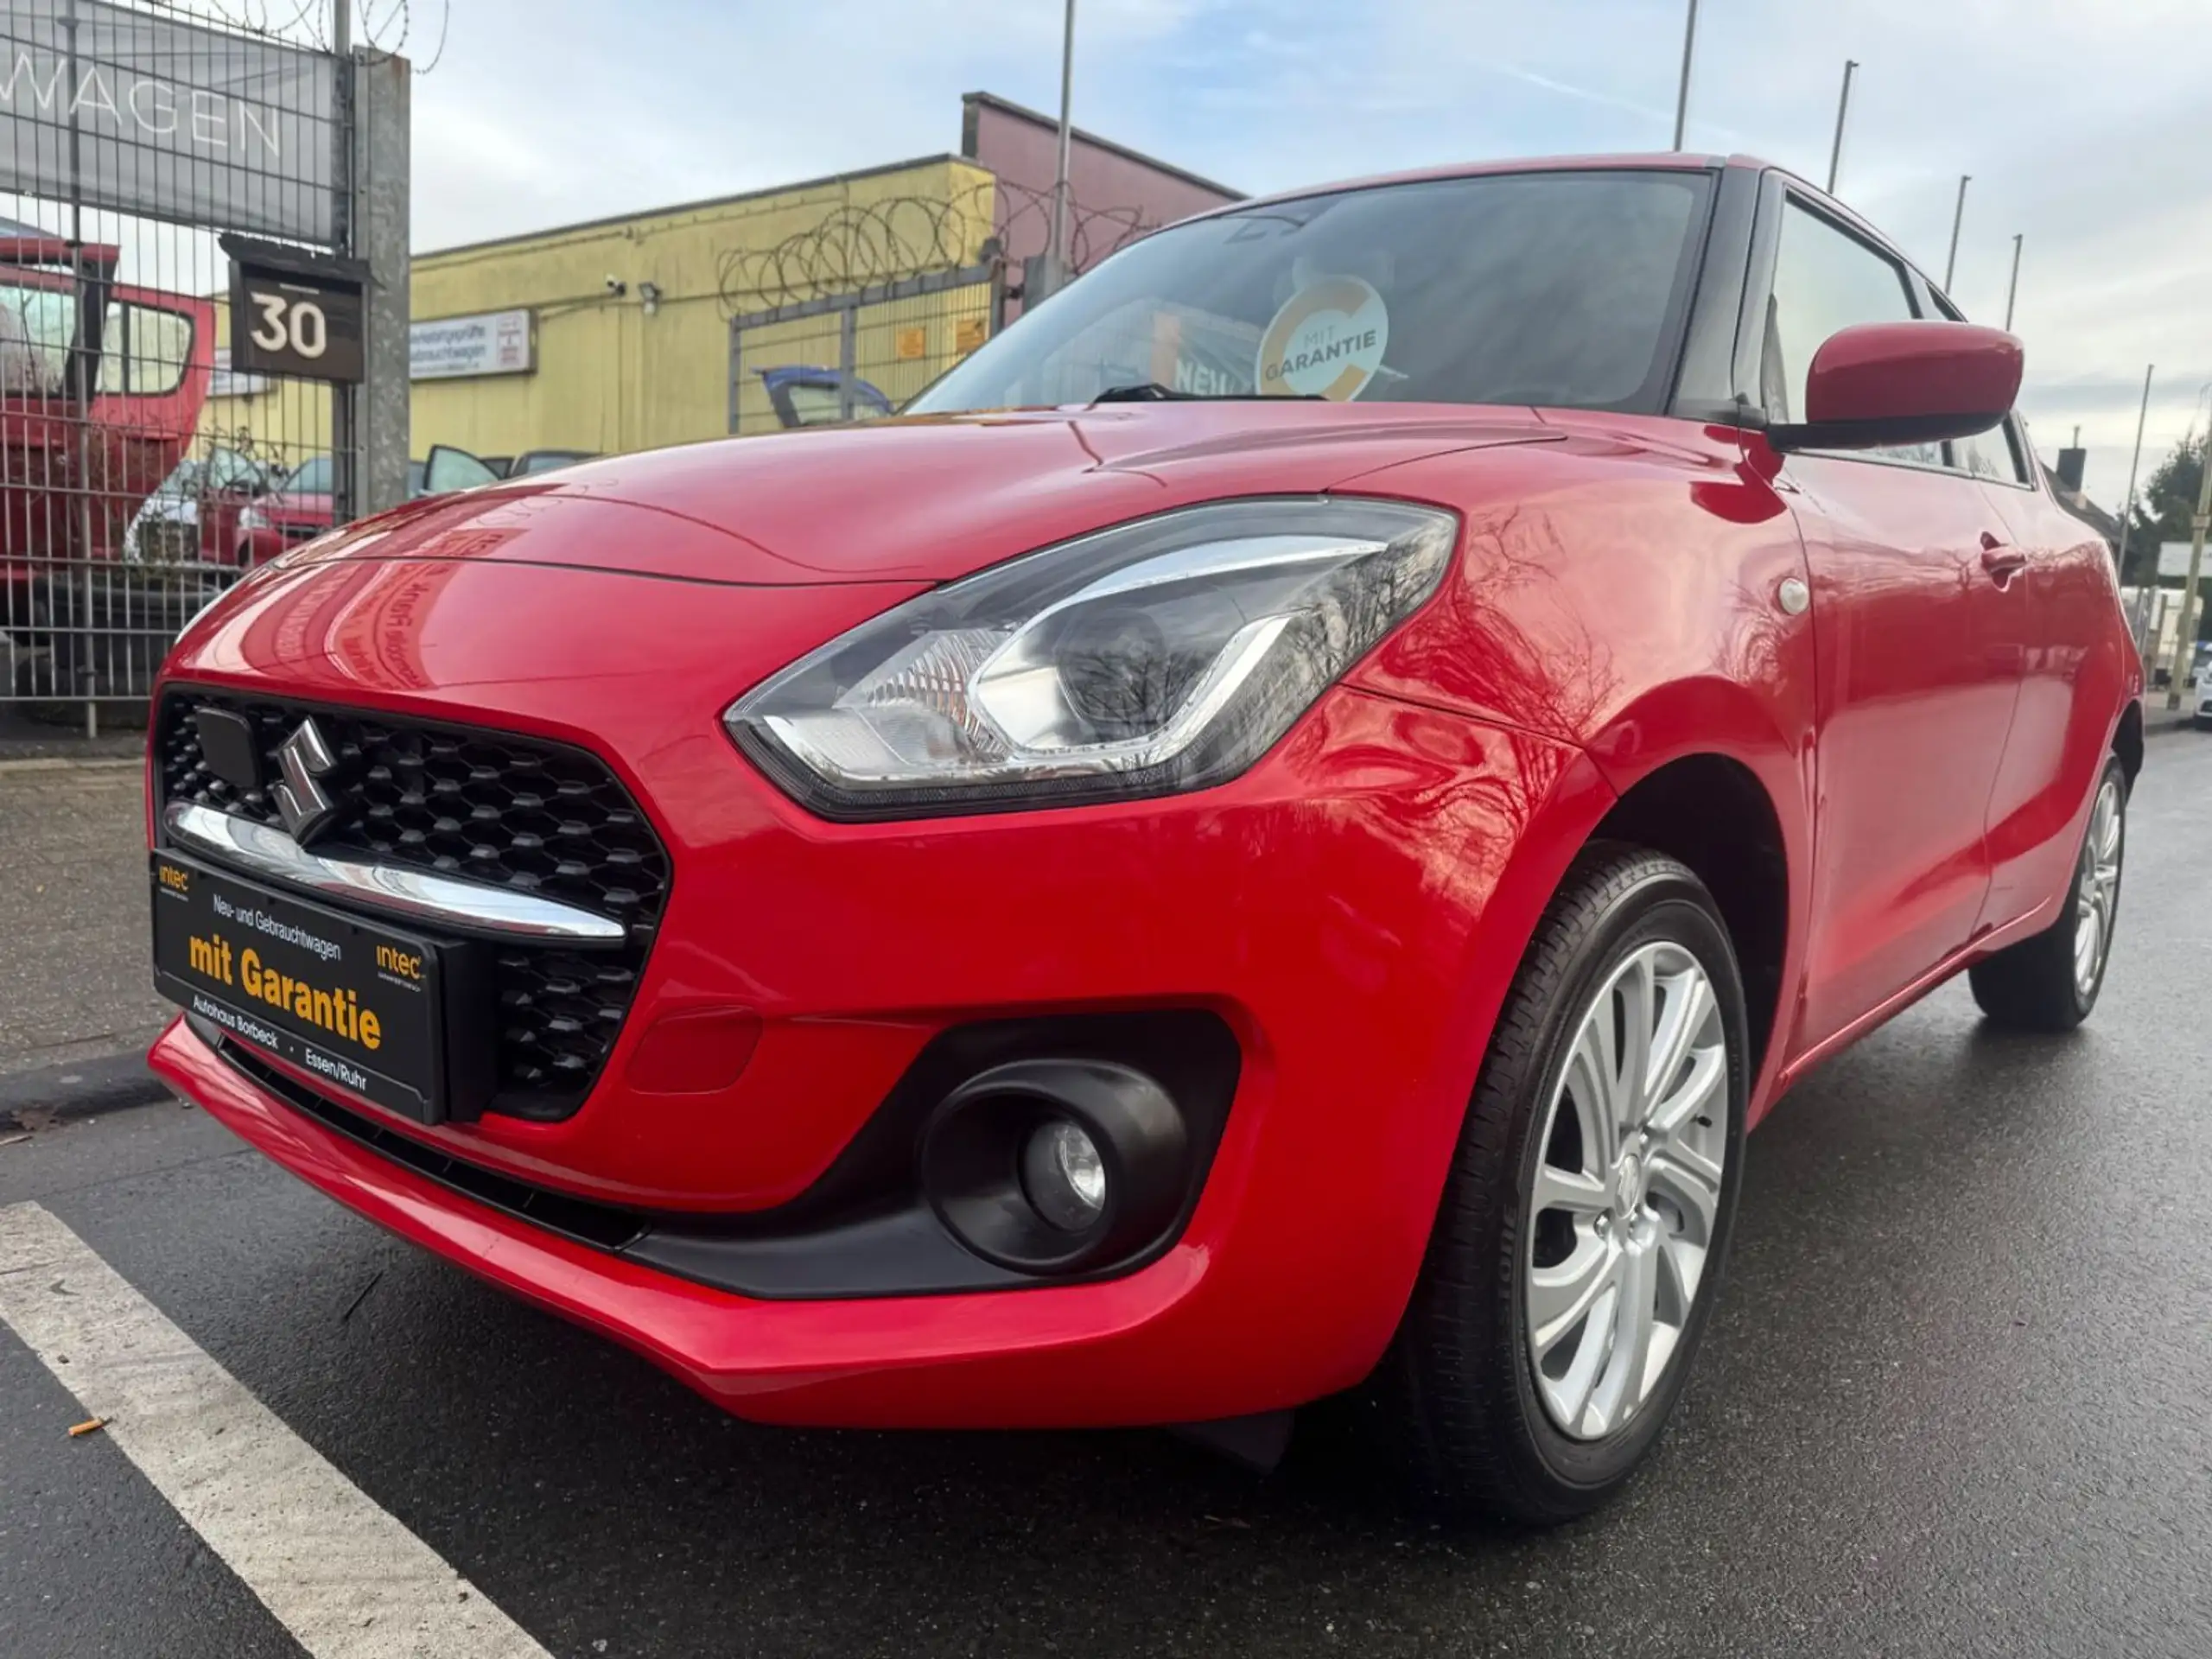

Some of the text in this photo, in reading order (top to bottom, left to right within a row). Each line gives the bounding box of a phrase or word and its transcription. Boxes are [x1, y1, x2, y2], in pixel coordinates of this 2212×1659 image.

[0, 52, 278, 156] WAGEN
[251, 291, 327, 359] 30
[1265, 329, 1376, 382] GARANTIE
[1304, 325, 1336, 347] MIT
[213, 893, 234, 918] Neu-
[235, 906, 253, 927] und
[256, 910, 341, 961] Gebrauchtwagen
[189, 934, 381, 1050] mit Garantie
[376, 944, 421, 980] intec
[193, 995, 367, 1091] Autohaus Borbeck Essen/Ruhr
